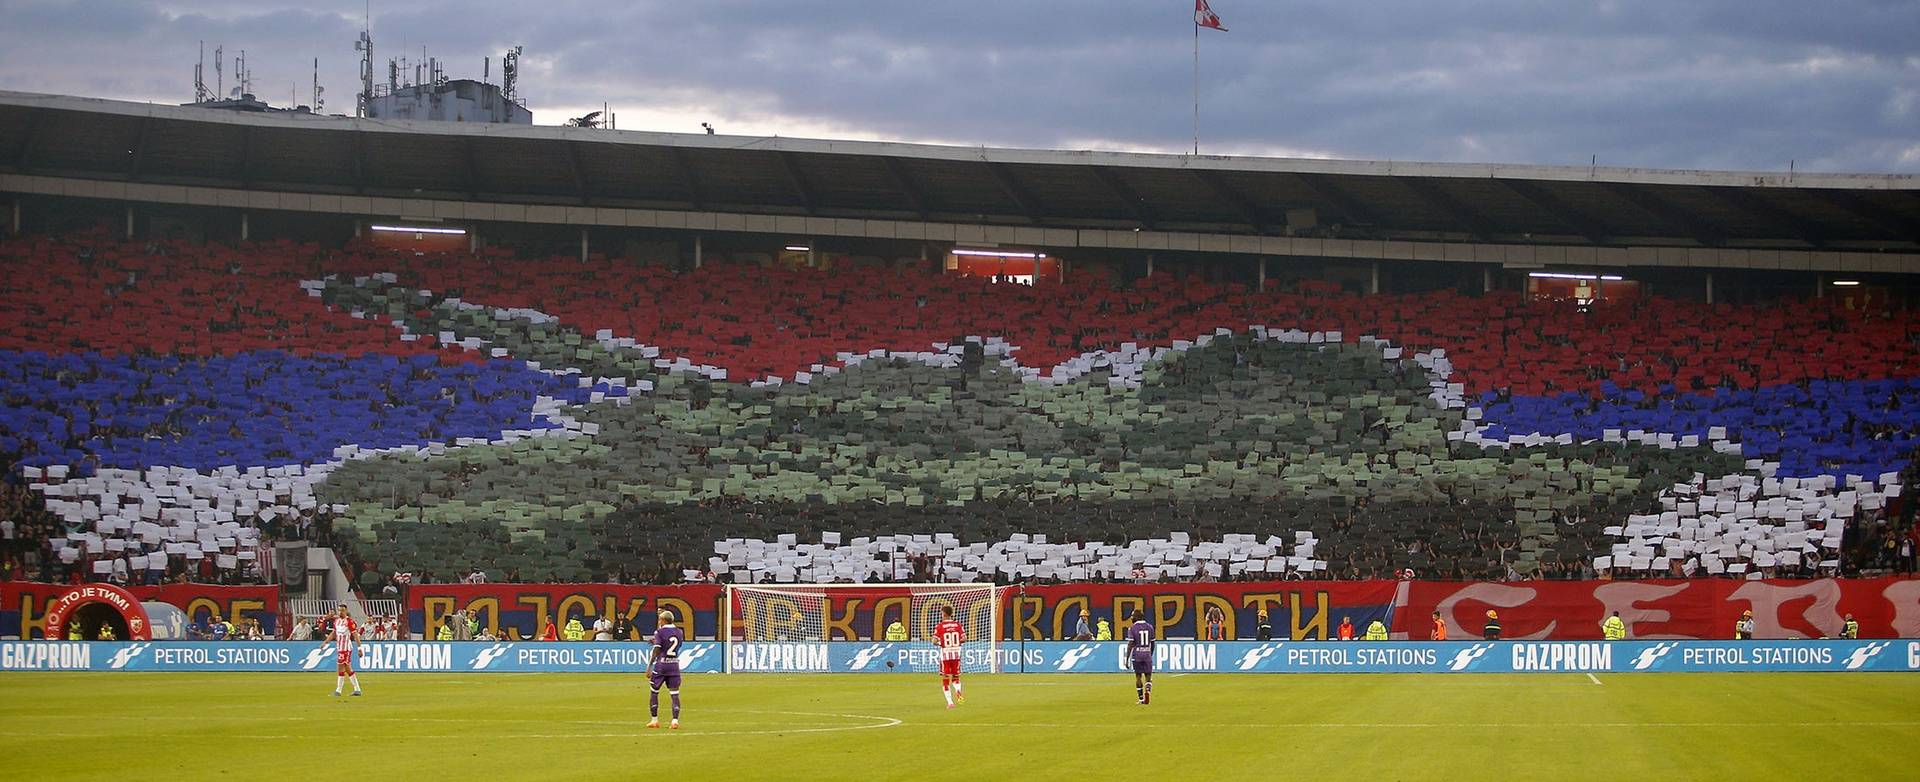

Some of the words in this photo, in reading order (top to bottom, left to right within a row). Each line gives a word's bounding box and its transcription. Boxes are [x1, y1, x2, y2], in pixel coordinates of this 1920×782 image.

[97, 587, 130, 611] ТИМ!
[667, 636, 678, 657] 2
[943, 631, 960, 648] 80
[1139, 630, 1149, 646] 11
[2, 643, 90, 669] GAZPROM
[155, 648, 213, 664] PETROL
[217, 648, 290, 664] STATIONS
[359, 643, 451, 670] GAZPROM
[518, 649, 579, 665] PETROL
[583, 649, 655, 665] STATION
[732, 644, 828, 670] GAZPROM
[898, 649, 943, 665] PETR
[965, 649, 1044, 666] STATIONS
[1118, 643, 1217, 671] GPROM
[1288, 649, 1352, 665] PETROL
[1356, 649, 1437, 665] STATIONS
[1512, 643, 1612, 670] GAZPROM
[1683, 648, 1748, 664] PETROL
[1752, 648, 1832, 664] STATIONS
